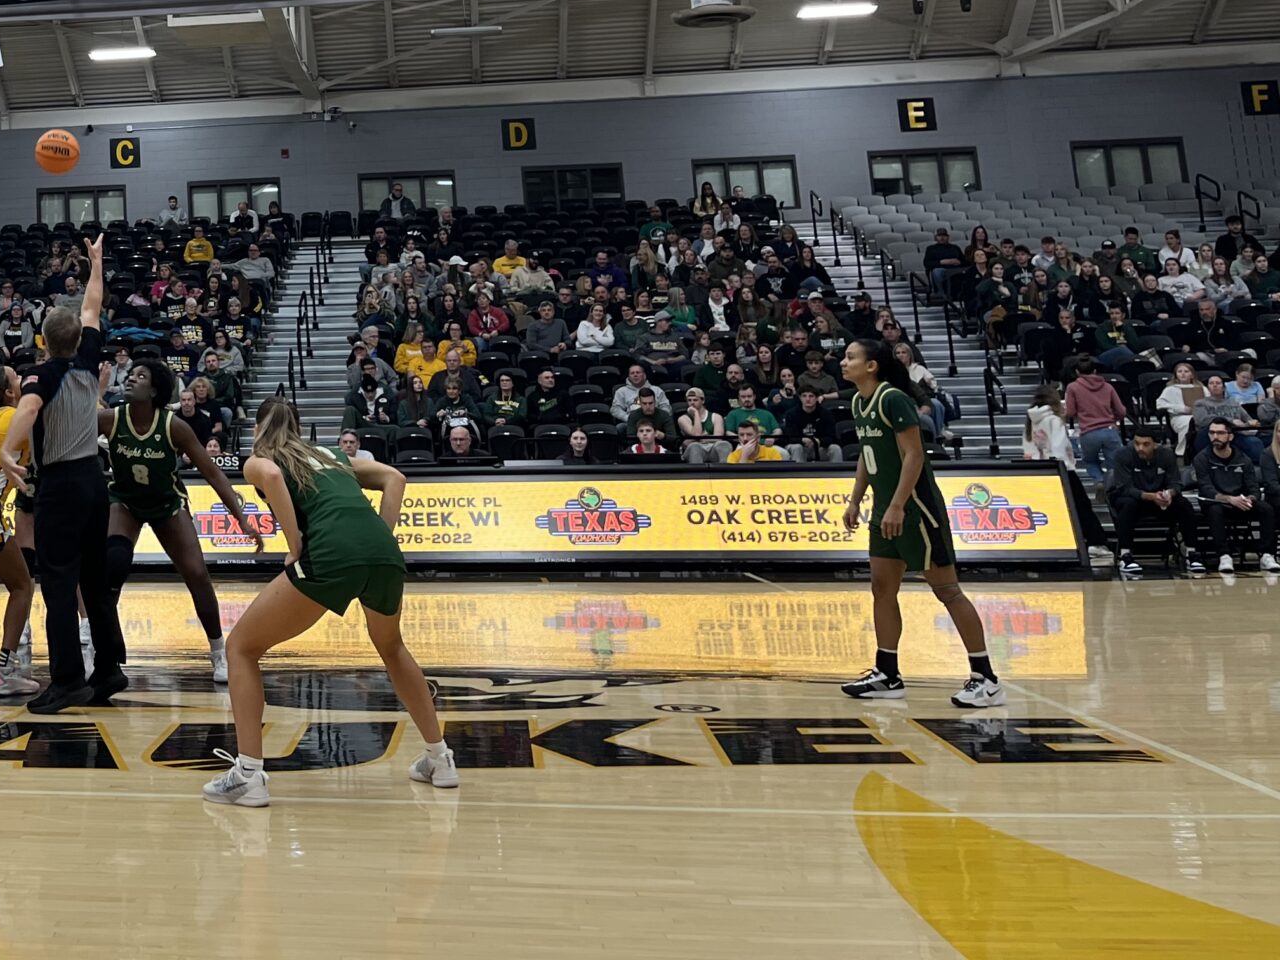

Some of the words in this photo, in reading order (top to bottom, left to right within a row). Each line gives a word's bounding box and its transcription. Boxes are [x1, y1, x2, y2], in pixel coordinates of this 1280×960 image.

[1251, 84, 1269, 112] F
[907, 101, 927, 128] E
[509, 122, 528, 147] D
[116, 140, 134, 165] C
[863, 445, 877, 475] 0
[132, 464, 149, 485] 8
[402, 497, 476, 508] OADWICK
[483, 497, 502, 508] PL
[680, 494, 719, 505] 1489
[725, 495, 745, 505] W.
[751, 493, 851, 505] BROADWICK
[197, 514, 274, 534] TEXAS
[397, 512, 460, 528] REEK,
[468, 511, 500, 526] WI
[551, 511, 636, 532] TEXAS
[687, 509, 742, 525] OAK
[751, 508, 838, 526] CREEK,
[947, 508, 1031, 530] TEXAS
[396, 533, 472, 544] 676-2022
[571, 534, 619, 543] ROADHOUSE
[721, 529, 762, 544] (414)
[768, 530, 853, 542] 676-2022
